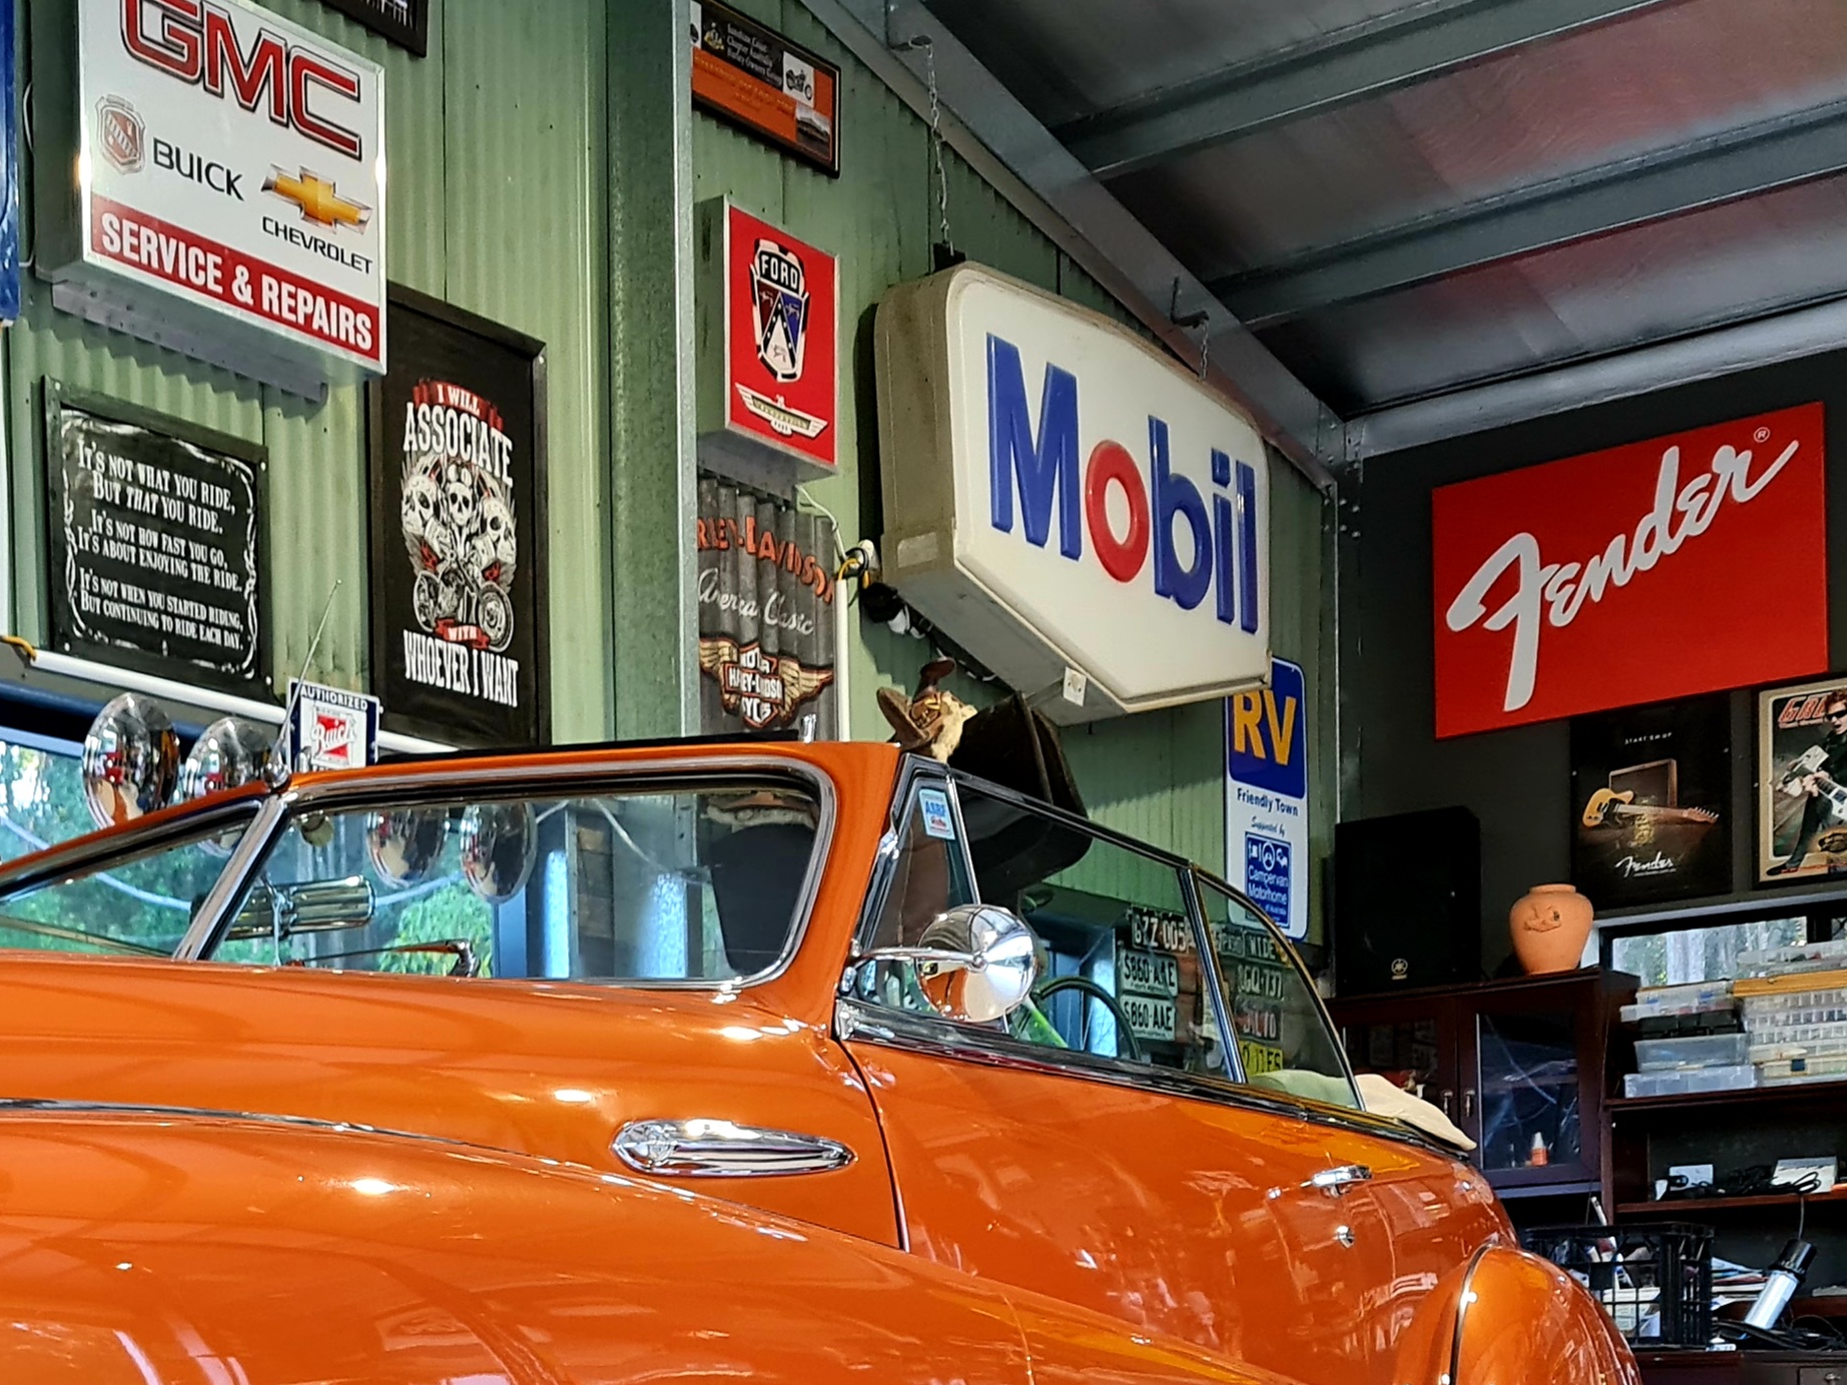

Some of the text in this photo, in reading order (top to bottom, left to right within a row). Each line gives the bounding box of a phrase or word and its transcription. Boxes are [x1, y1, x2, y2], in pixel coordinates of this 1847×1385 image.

[120, 0, 362, 161] GMC
[153, 136, 245, 202] BUICK
[262, 216, 373, 275] CHEVROLET
[101, 213, 373, 351] SERVICE & REPAIRS
[760, 253, 799, 290] FORD
[445, 386, 481, 417] WILL
[403, 402, 514, 488] ASSOCIATE
[108, 454, 135, 483] NOT
[137, 463, 171, 496] WHAT
[174, 472, 198, 500] YOU
[200, 483, 236, 516] RIDE,
[986, 332, 1259, 635] Mobil
[126, 485, 160, 516] THAT
[161, 495, 186, 523] YOU
[188, 506, 224, 535] RIDE.
[102, 539, 137, 564] ABOUT
[139, 547, 189, 578] ENJOYING
[190, 562, 212, 585] THE
[213, 569, 243, 592] RIDE.
[116, 520, 136, 543] NOT
[138, 528, 160, 549] HOW
[161, 535, 186, 557] FAST
[188, 543, 208, 563] YOU
[101, 577, 120, 599] NOT
[121, 583, 147, 606] WHEN
[148, 590, 166, 610] YOU
[167, 595, 207, 621] STARTED
[1446, 439, 1800, 713] Fender
[103, 601, 159, 630] CONTINUING
[161, 614, 174, 633] TO
[175, 618, 198, 639] RIDE
[199, 625, 222, 645] EACH
[404, 628, 519, 709] WHOEVER I WANT
[300, 684, 369, 712] AUTHORIZED
[1232, 687, 1297, 768] RV
[1236, 787, 1299, 817] Friendly Town
[1248, 865, 1289, 888] Campervan
[1614, 850, 1674, 879] Fender
[1248, 881, 1288, 905] Motorhome
